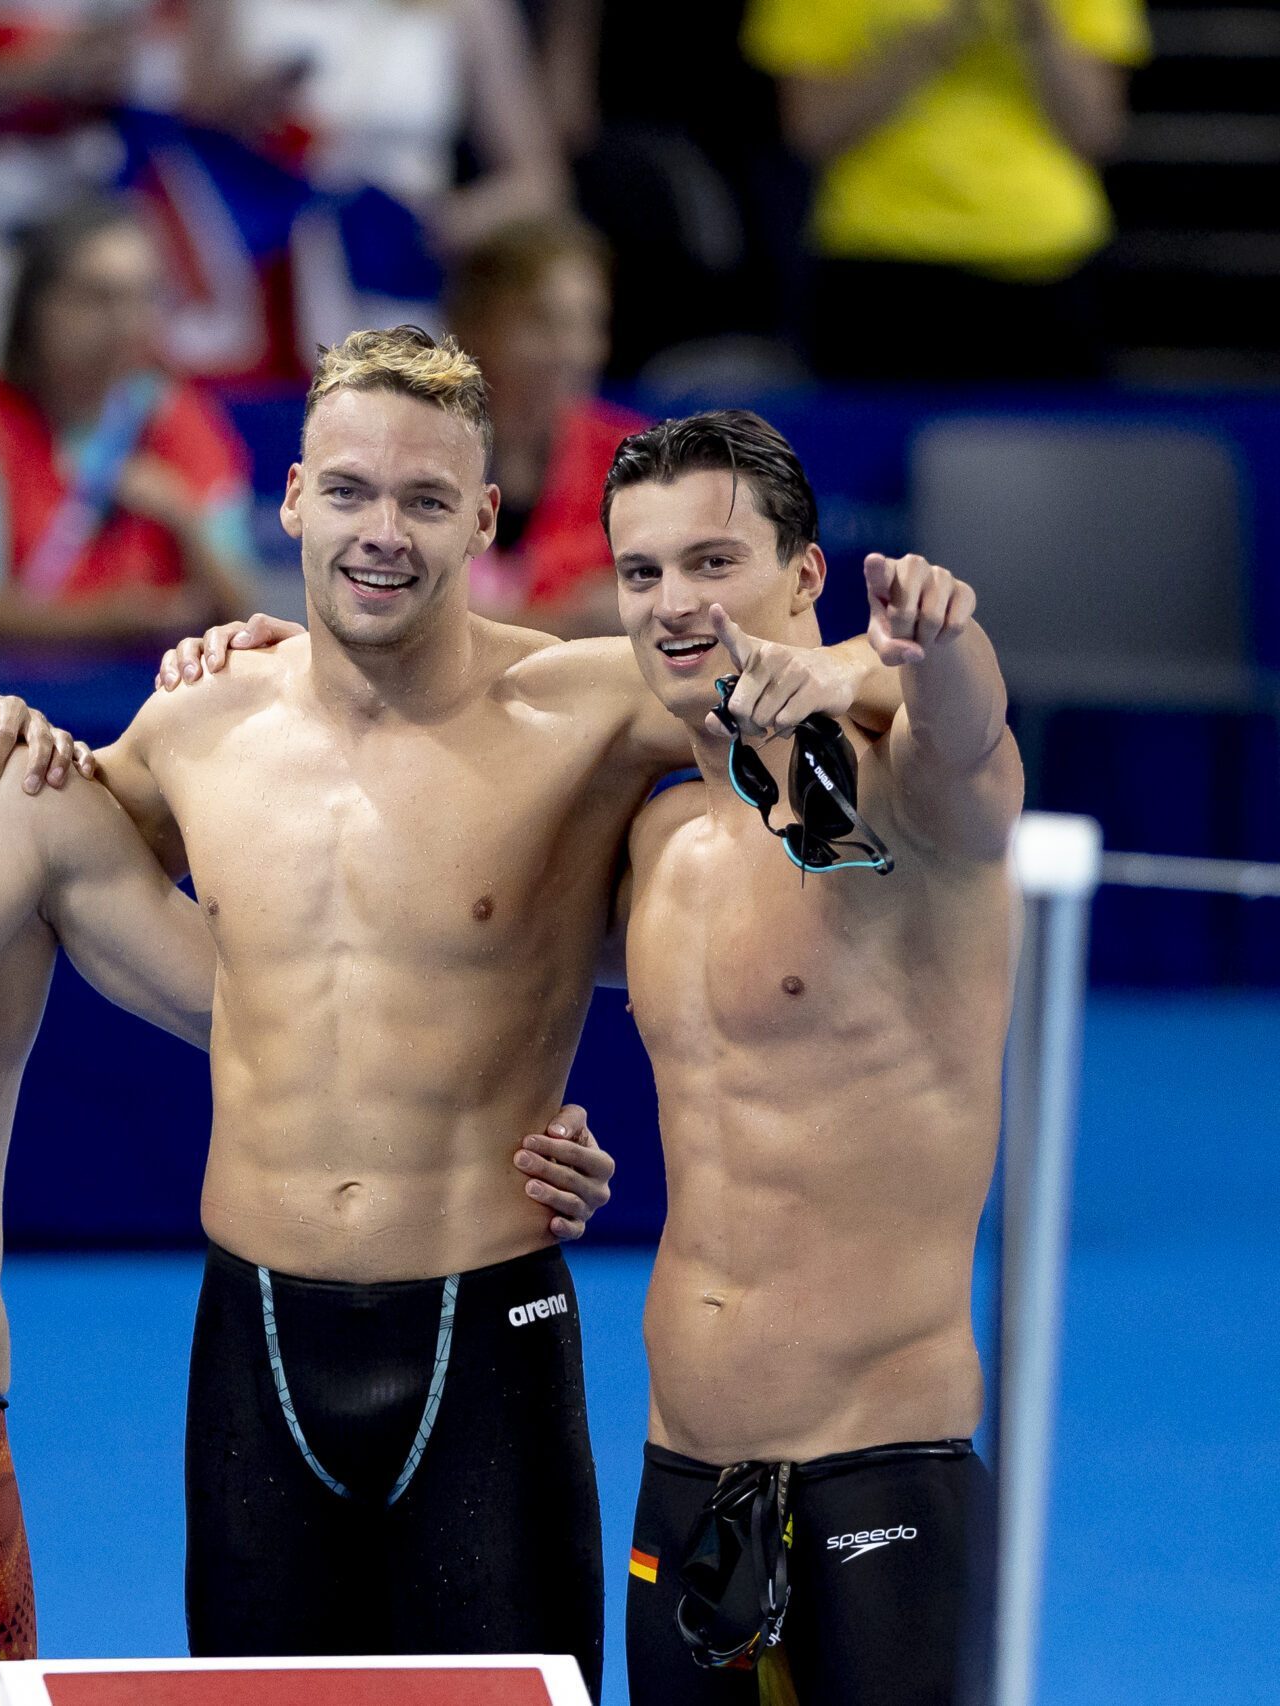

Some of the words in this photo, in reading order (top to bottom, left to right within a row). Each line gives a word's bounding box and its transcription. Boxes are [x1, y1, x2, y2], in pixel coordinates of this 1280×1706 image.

[814, 765, 834, 791] arena
[508, 1293, 568, 1327] arena
[826, 1525, 917, 1550] speedo
